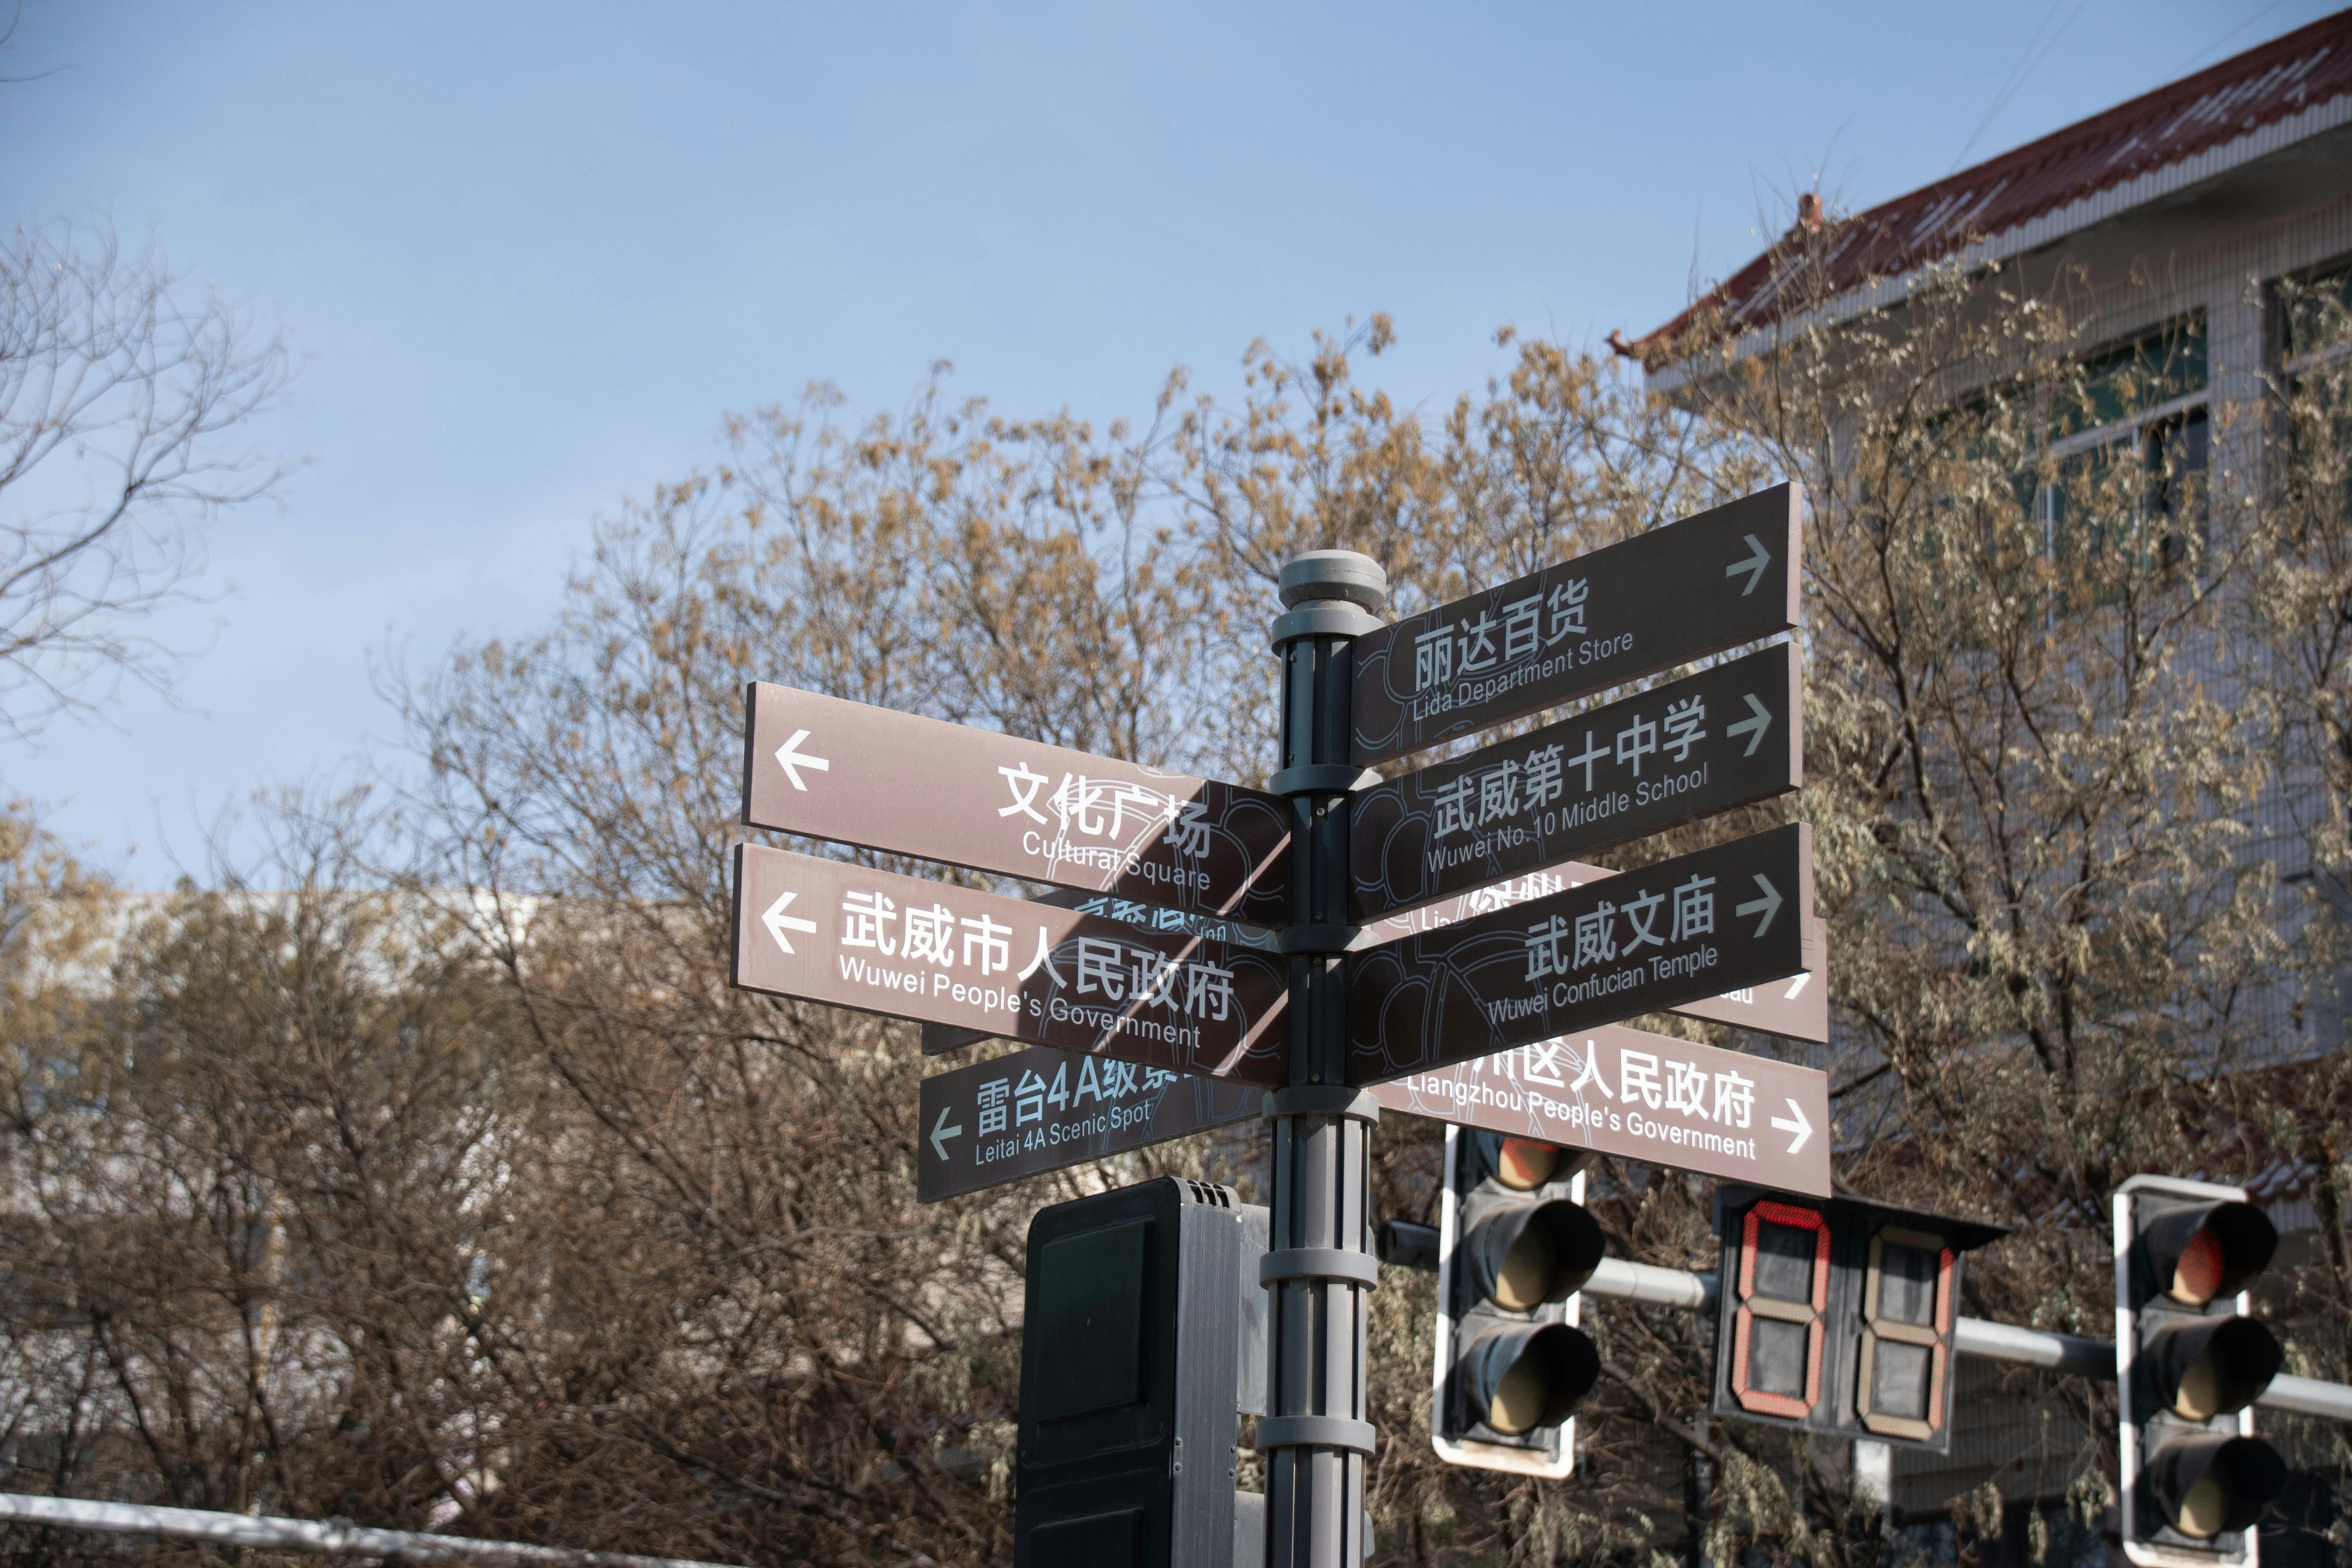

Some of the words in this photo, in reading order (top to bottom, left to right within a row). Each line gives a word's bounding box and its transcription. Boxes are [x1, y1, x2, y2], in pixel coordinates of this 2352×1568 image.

[1414, 691, 1451, 721] Lida
[1459, 648, 1573, 706] Department
[1579, 633, 1633, 665] Store
[1415, 578, 1588, 691] 丽达百货
[998, 762, 1210, 858] 文化广场
[1434, 695, 1706, 839] 武威第十中学
[1023, 831, 1117, 871] Cultural
[1126, 852, 1210, 890] Square
[1428, 833, 1490, 873] Wuwei
[1563, 791, 1629, 830] Middle
[1636, 762, 1707, 806] School
[841, 891, 1234, 1021] 武威市人民政府
[1525, 873, 1715, 982] 武威文庙
[840, 955, 924, 994] Wuwei
[934, 973, 1042, 1016] People's
[1050, 997, 1200, 1048] Government
[1488, 987, 1548, 1024] Wuwei
[1553, 965, 1644, 1007] Confucian
[1649, 944, 1717, 980] Temple
[976, 1134, 1019, 1165] Leitai
[1024, 1127, 1046, 1151] 4A
[1050, 1113, 1106, 1145] Scenic
[1111, 1099, 1149, 1131] Spot
[1407, 1072, 1521, 1111] Liangzhou
[1529, 1091, 1621, 1131] People's
[1627, 1112, 1756, 1160] Government
